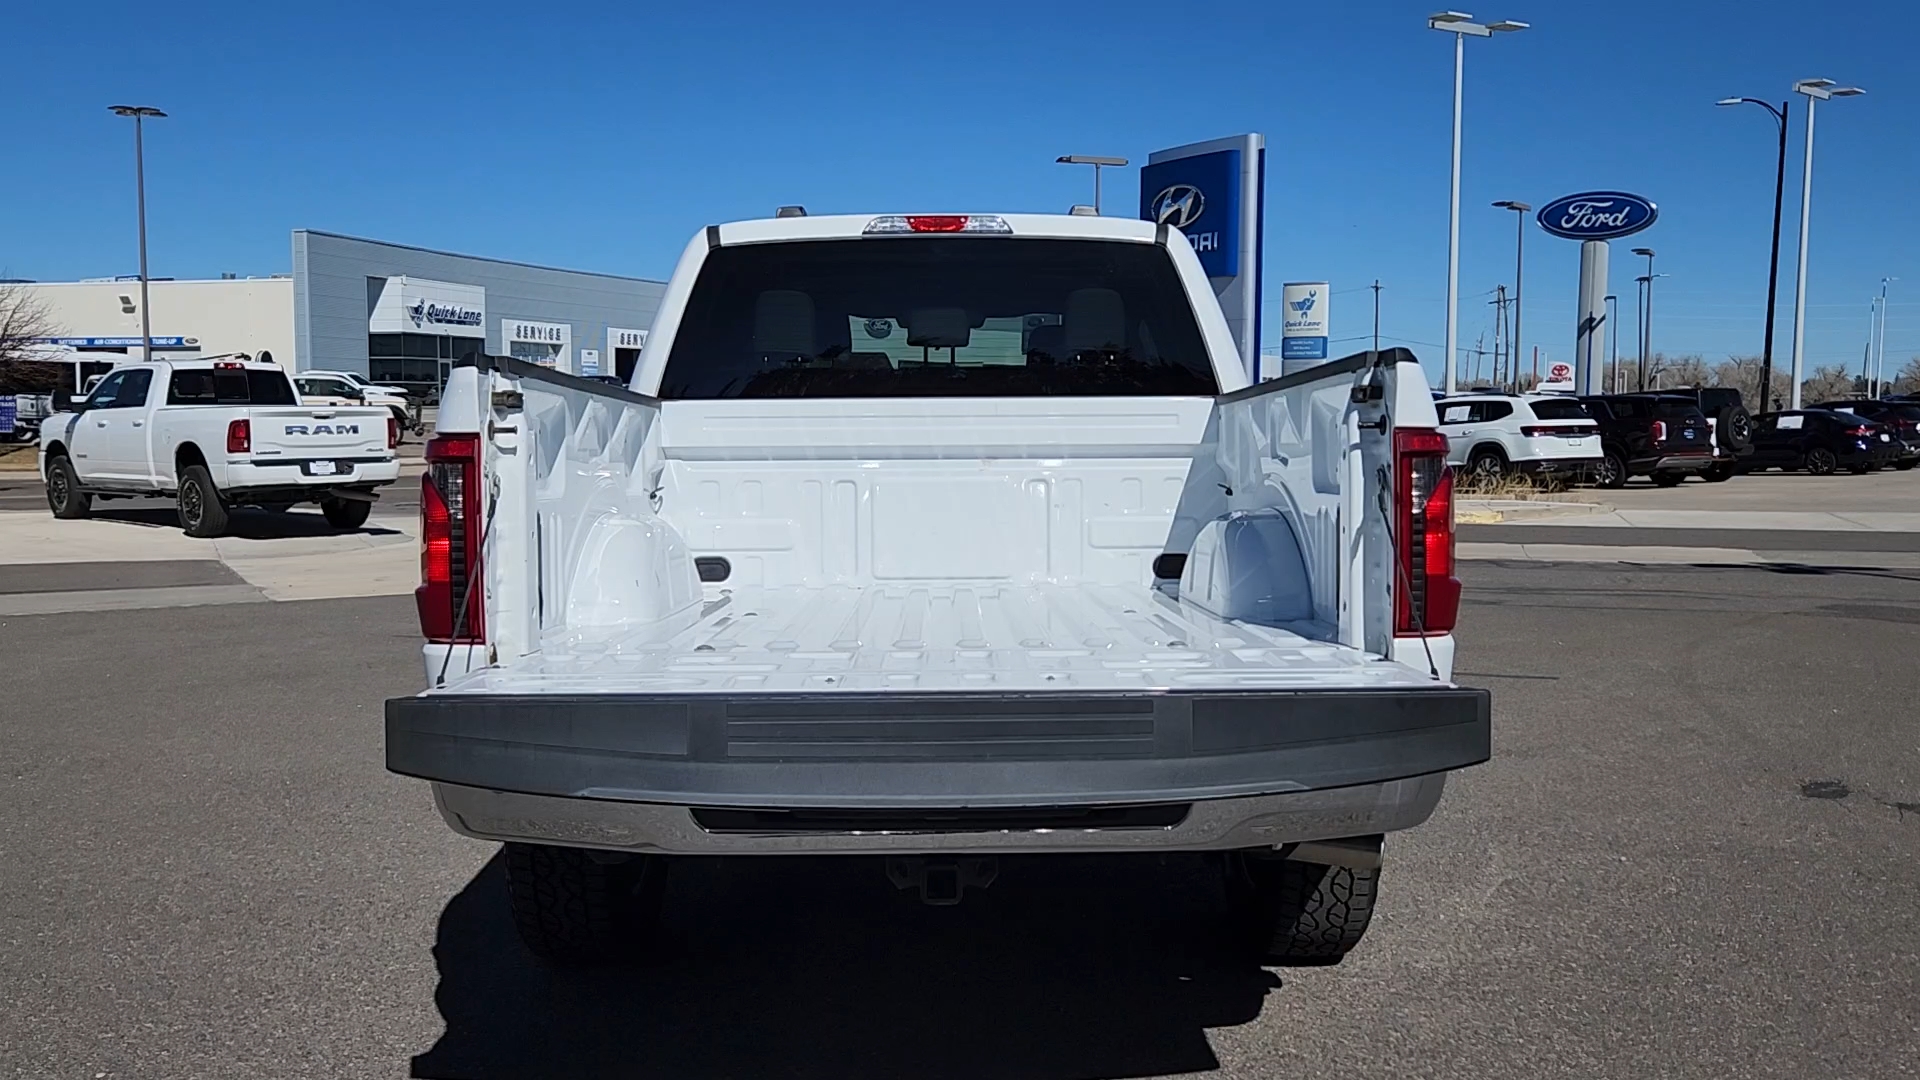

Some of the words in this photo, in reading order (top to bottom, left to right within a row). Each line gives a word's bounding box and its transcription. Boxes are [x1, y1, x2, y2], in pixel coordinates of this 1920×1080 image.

[1561, 201, 1631, 228] Ford
[426, 303, 457, 320] Quick
[458, 306, 482, 322] Lane
[1285, 320, 1302, 328] Quick
[515, 325, 561, 341] SERVICE
[285, 425, 359, 435] RAM
